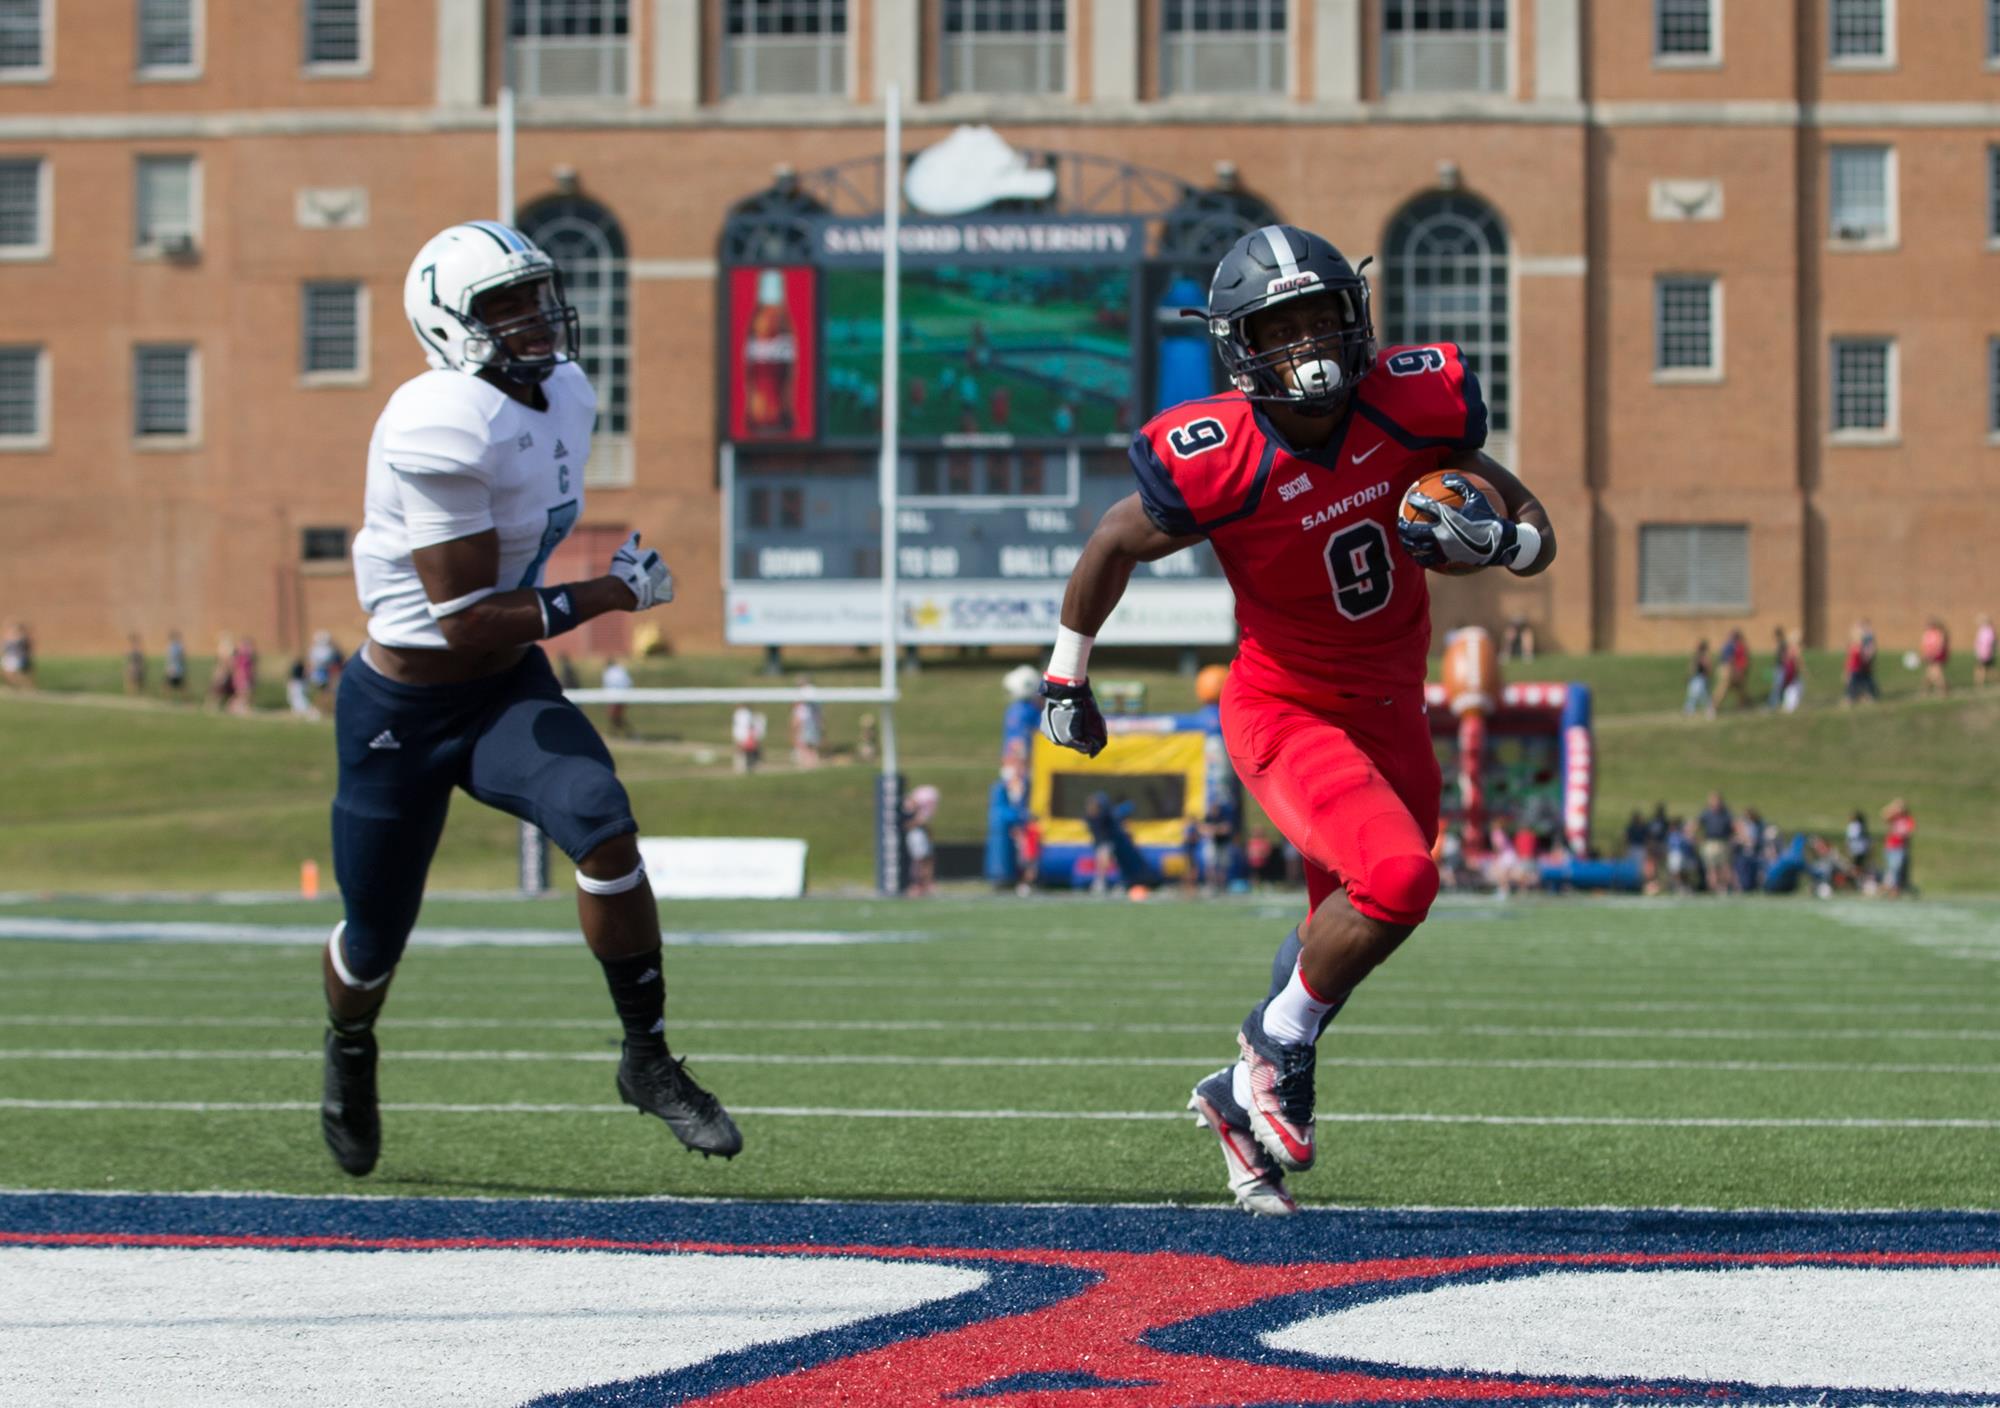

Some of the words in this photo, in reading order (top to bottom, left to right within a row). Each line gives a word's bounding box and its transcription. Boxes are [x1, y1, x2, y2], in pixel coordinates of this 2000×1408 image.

[824, 225, 961, 252] SAMORD
[964, 224, 1131, 252] UNIVERSITY
[1166, 416, 1228, 460] 9
[1277, 472, 1314, 502] SOCON
[1301, 481, 1390, 531] SAMFORD
[759, 547, 824, 578] DOWN
[899, 547, 926, 578] TO
[1001, 546, 1050, 577] BALL
[1323, 517, 1396, 622] 9
